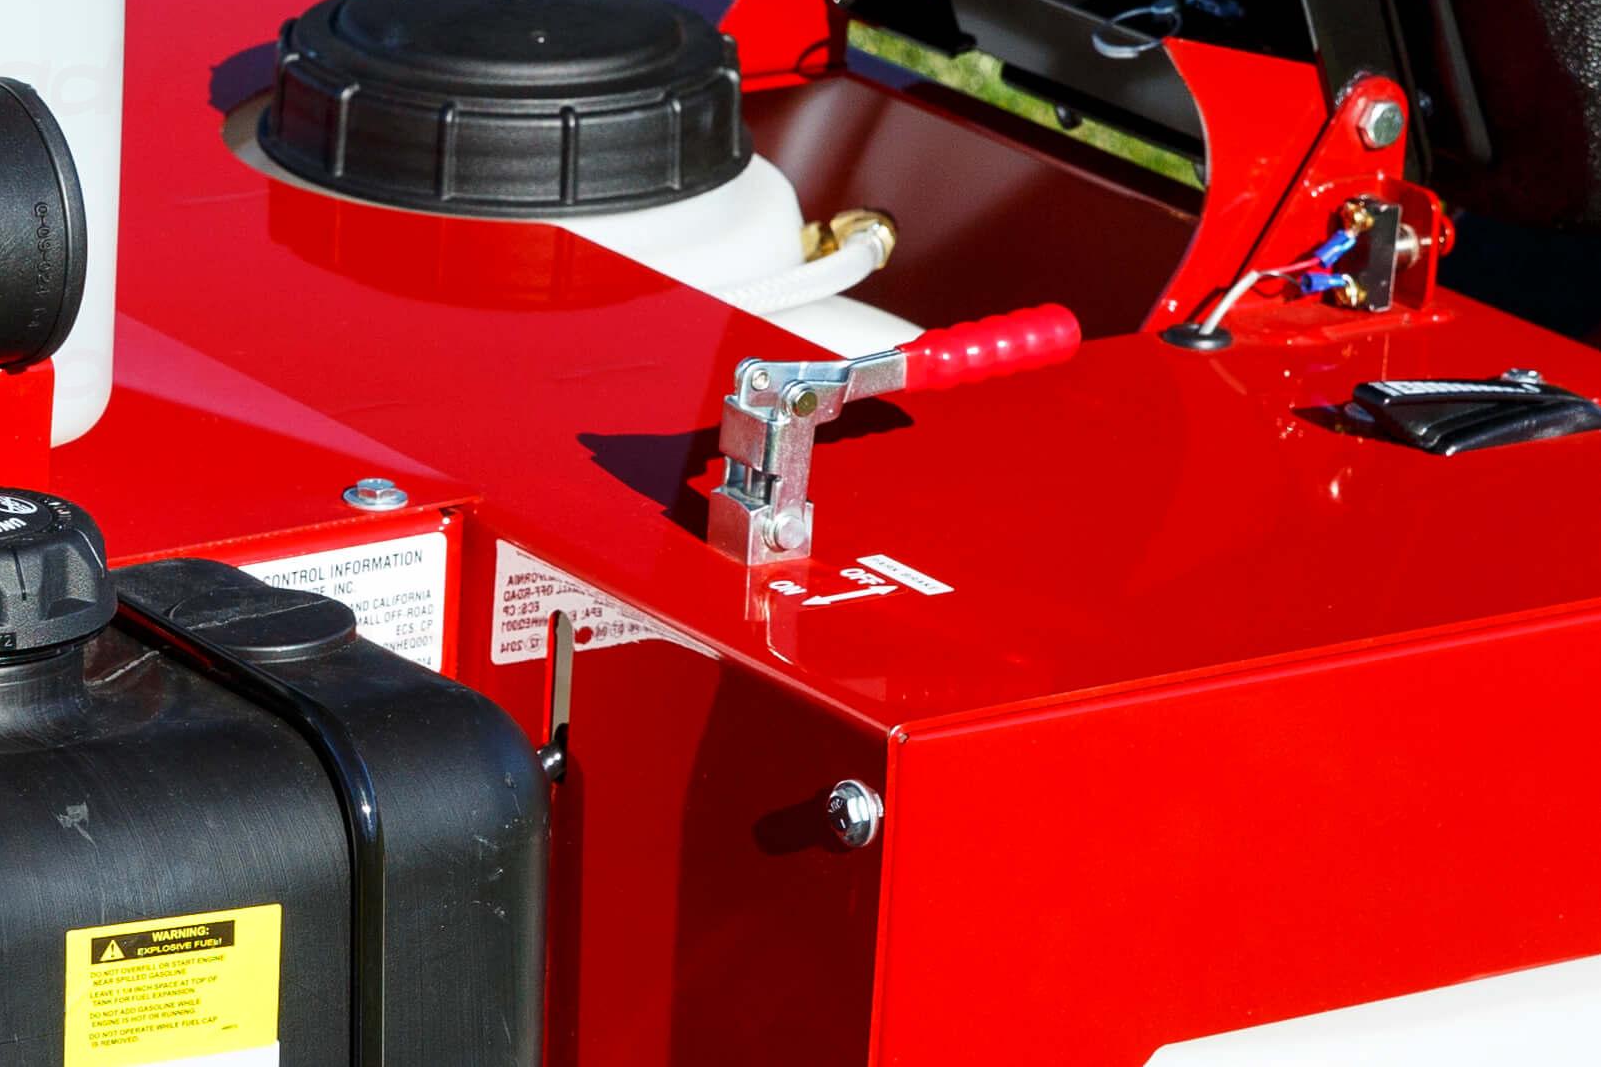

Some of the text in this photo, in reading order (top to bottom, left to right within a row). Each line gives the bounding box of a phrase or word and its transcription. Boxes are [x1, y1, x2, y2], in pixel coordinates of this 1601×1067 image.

[331, 549, 423, 579] INFORMATION
[840, 567, 886, 585] OFF
[768, 580, 807, 596] ON
[373, 590, 432, 609] CALIFORNIA
[420, 620, 434, 633] CP
[152, 926, 210, 942] WARNING:
[137, 942, 192, 957] EXPLOSIVE
